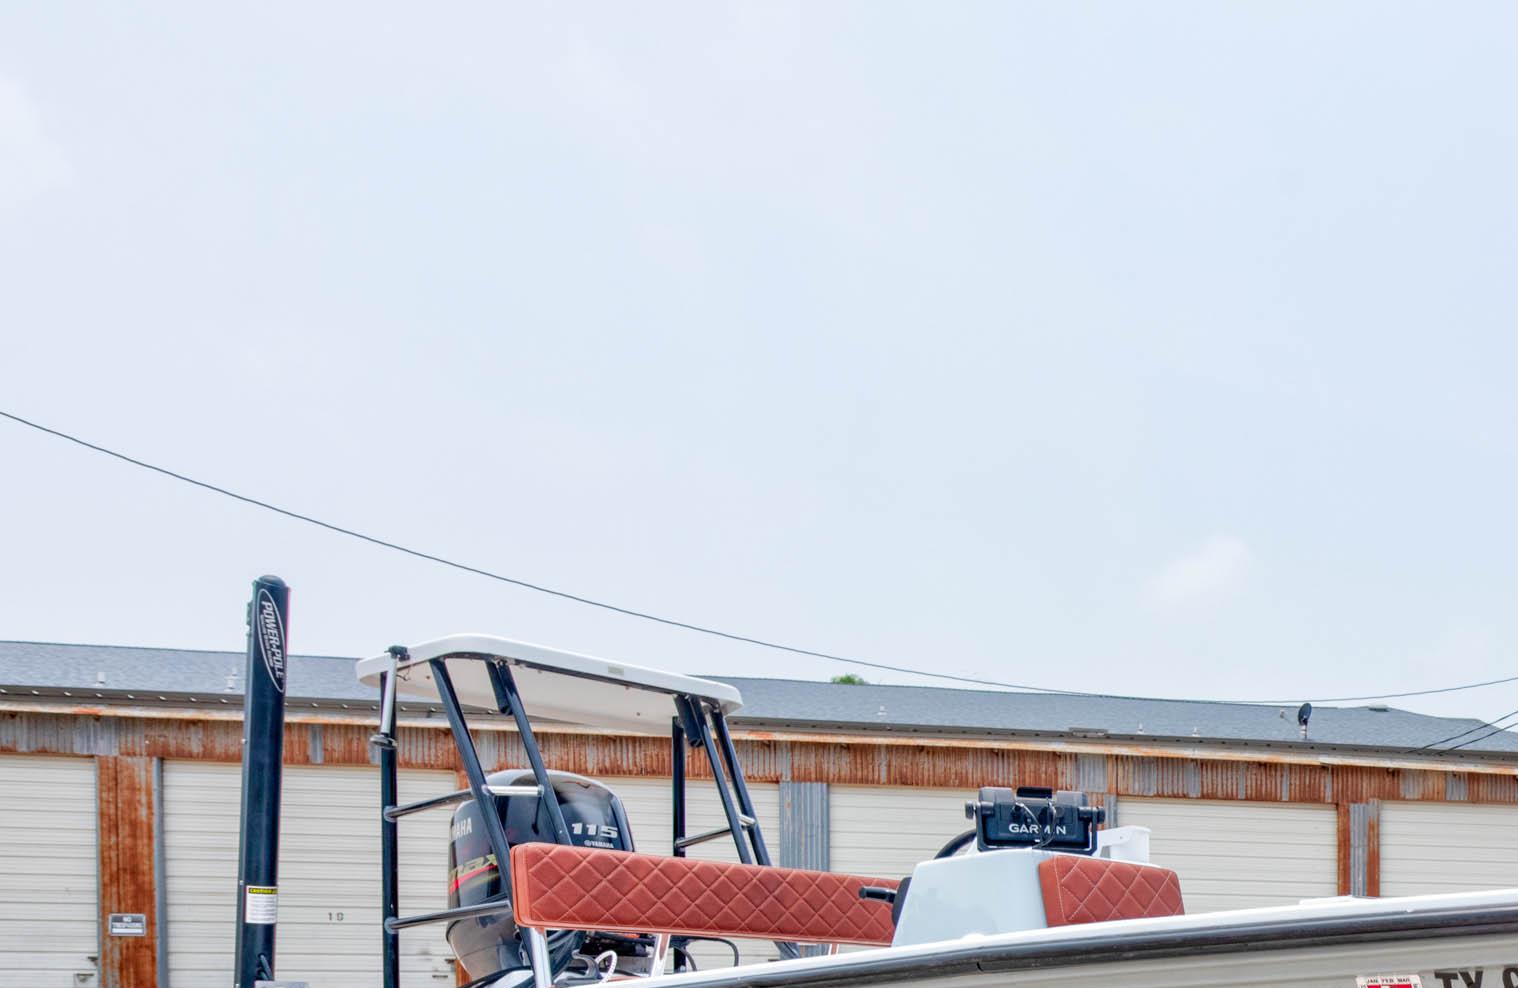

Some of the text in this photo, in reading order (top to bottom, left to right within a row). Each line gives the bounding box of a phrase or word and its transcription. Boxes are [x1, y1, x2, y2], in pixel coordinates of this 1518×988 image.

[261, 600, 285, 679] POWER-POLE
[571, 822, 618, 840] 115
[1008, 823, 1067, 835] GARMN
